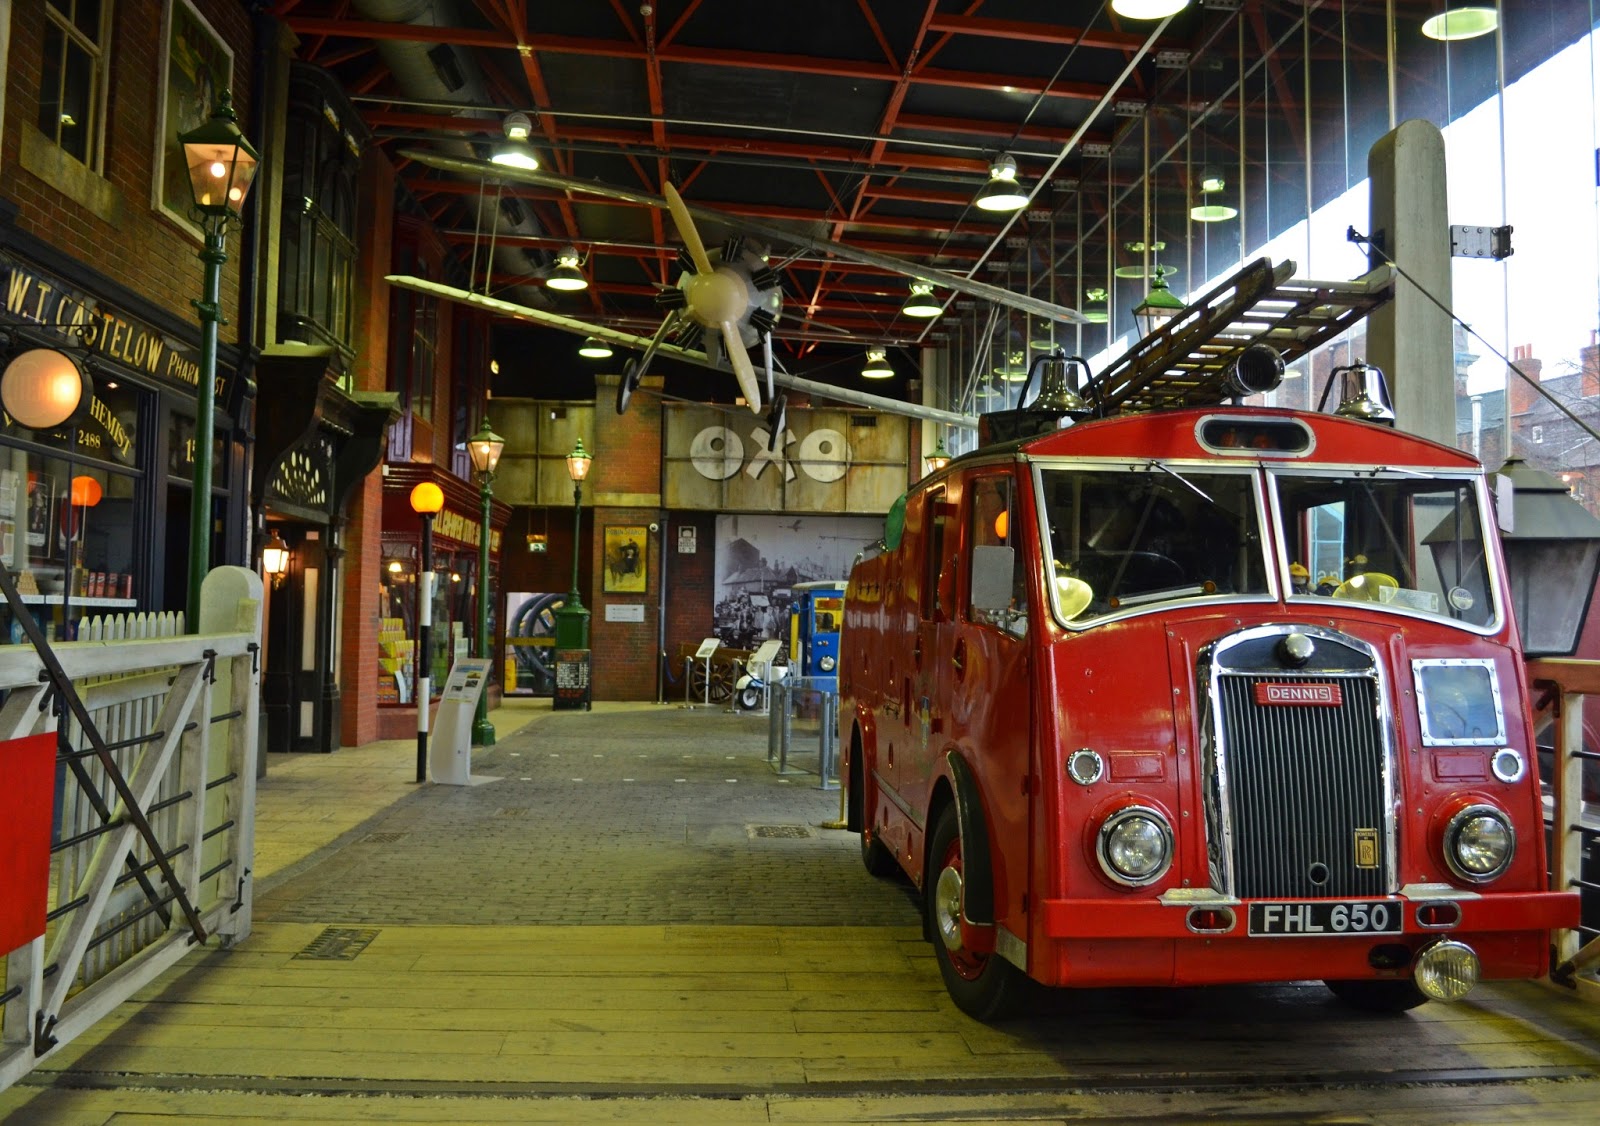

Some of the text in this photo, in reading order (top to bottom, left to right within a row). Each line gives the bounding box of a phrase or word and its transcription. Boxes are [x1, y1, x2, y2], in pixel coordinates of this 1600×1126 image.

[56, 295, 164, 373] CASTELOW
[78, 429, 101, 448] 2488
[89, 394, 132, 458] HEMIST
[690, 425, 852, 483] OXO
[1269, 686, 1330, 700] DENNIS
[1263, 903, 1389, 933] FHL 650
